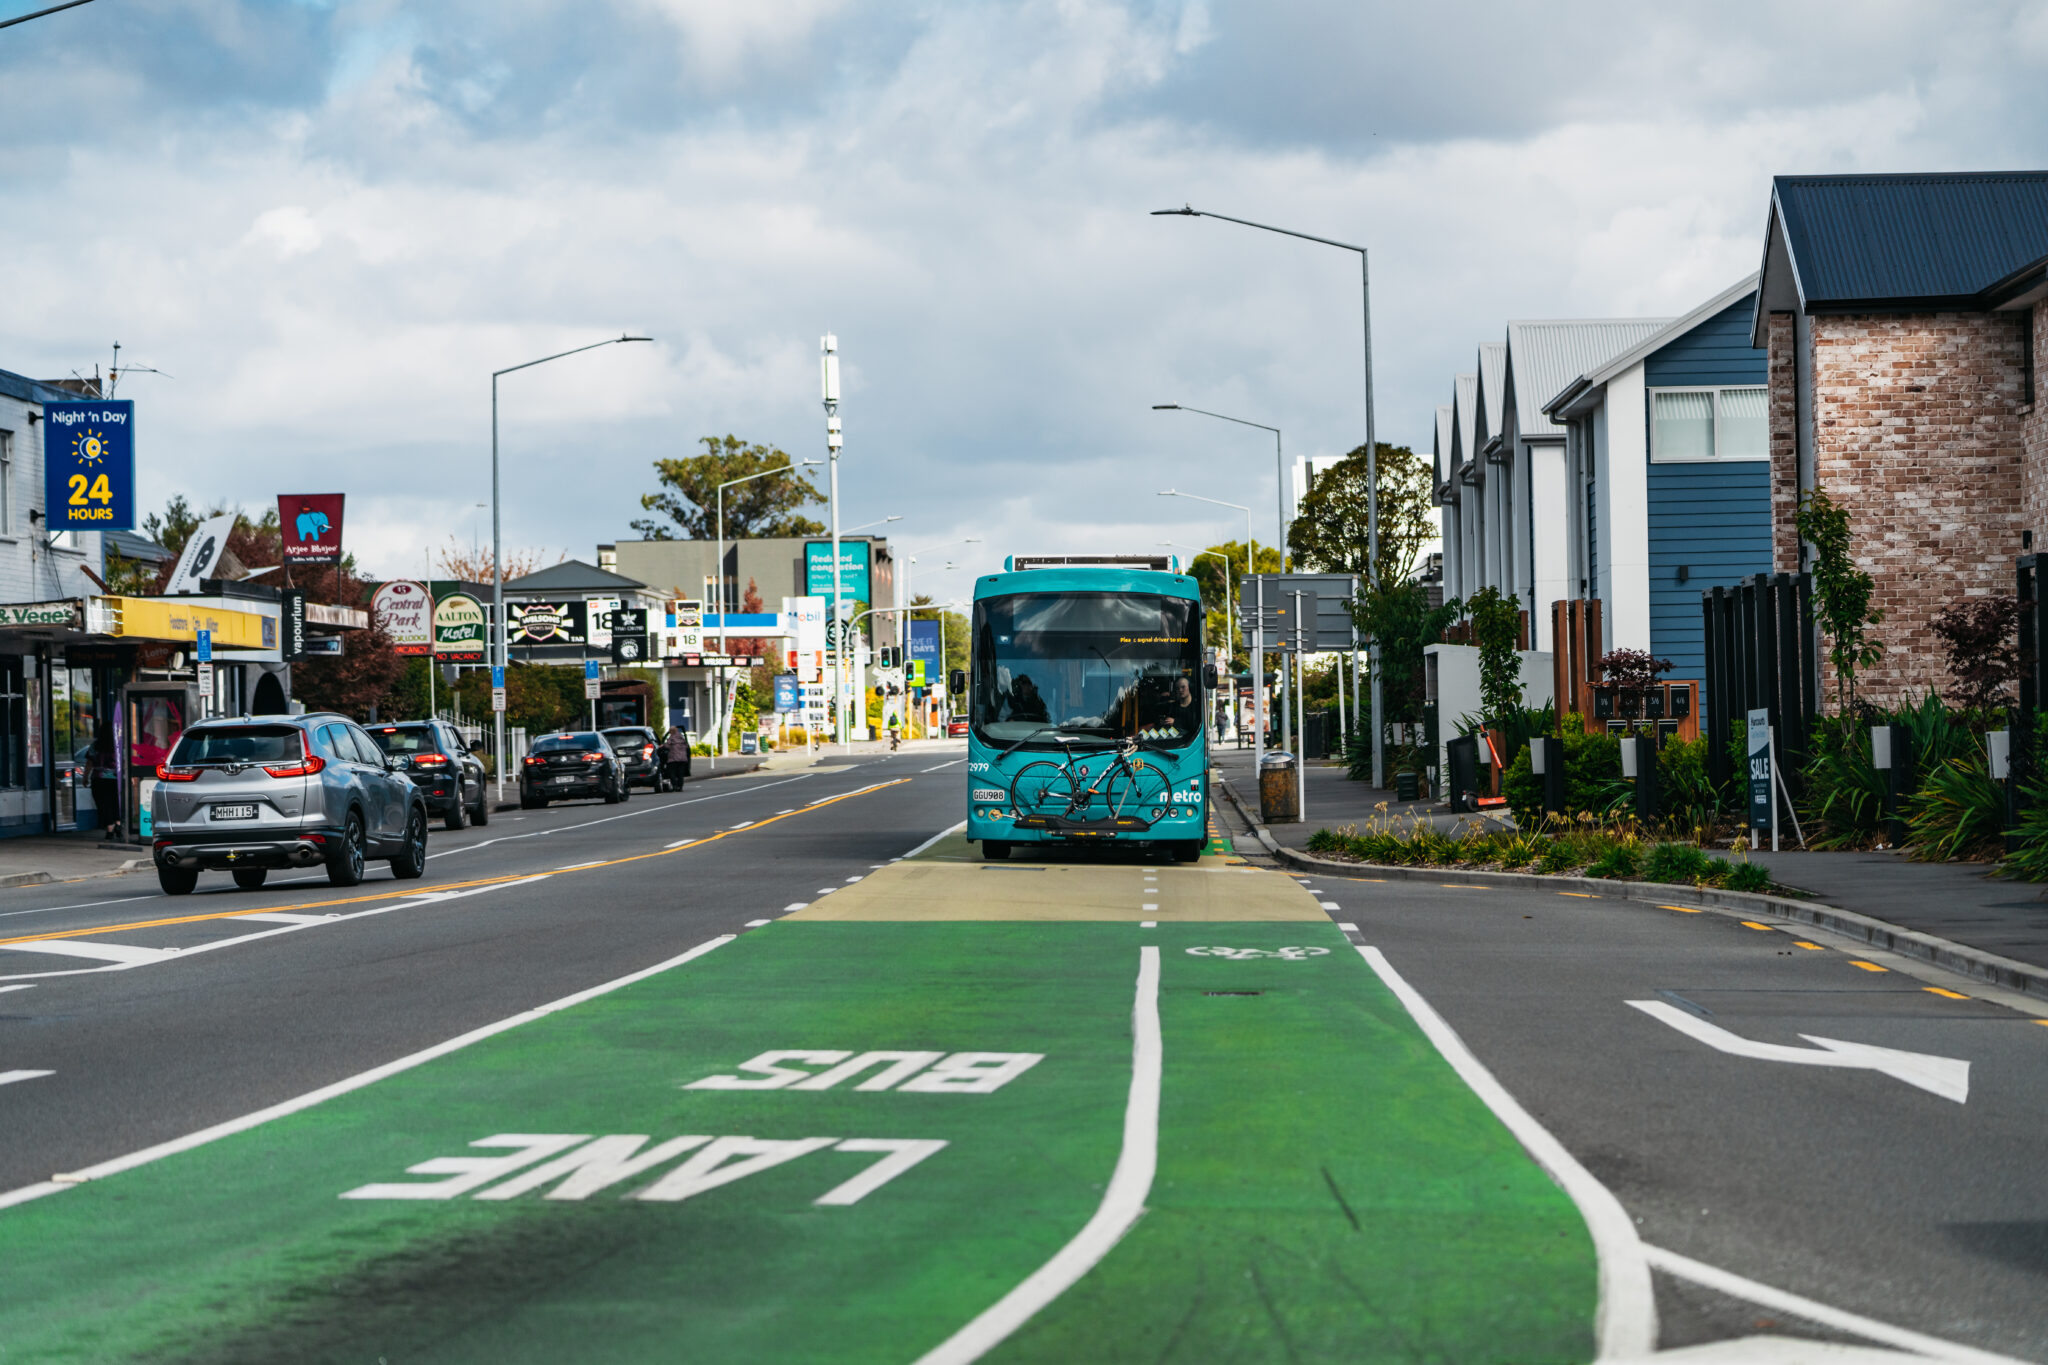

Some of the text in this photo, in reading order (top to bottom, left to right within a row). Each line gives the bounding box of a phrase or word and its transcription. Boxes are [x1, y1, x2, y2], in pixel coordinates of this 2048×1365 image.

[52, 411, 85, 426] Night
[102, 411, 127, 425] Day
[68, 473, 113, 505] 24
[68, 508, 113, 520] HOURS
[811, 554, 852, 563] Redued
[811, 563, 864, 573] congstion
[376, 596, 426, 611] Central
[382, 612, 422, 630] Park
[437, 612, 479, 621] AALTON
[521, 615, 561, 625] WILSONS
[293, 596, 303, 654] vapourium
[439, 625, 476, 641] Motel
[684, 635, 697, 645] 18
[1751, 757, 1770, 780] SALE
[1159, 789, 1202, 803] metro
[216, 805, 252, 818] MHH115
[683, 1050, 1045, 1093] BUS
[339, 1134, 948, 1206] LANE
